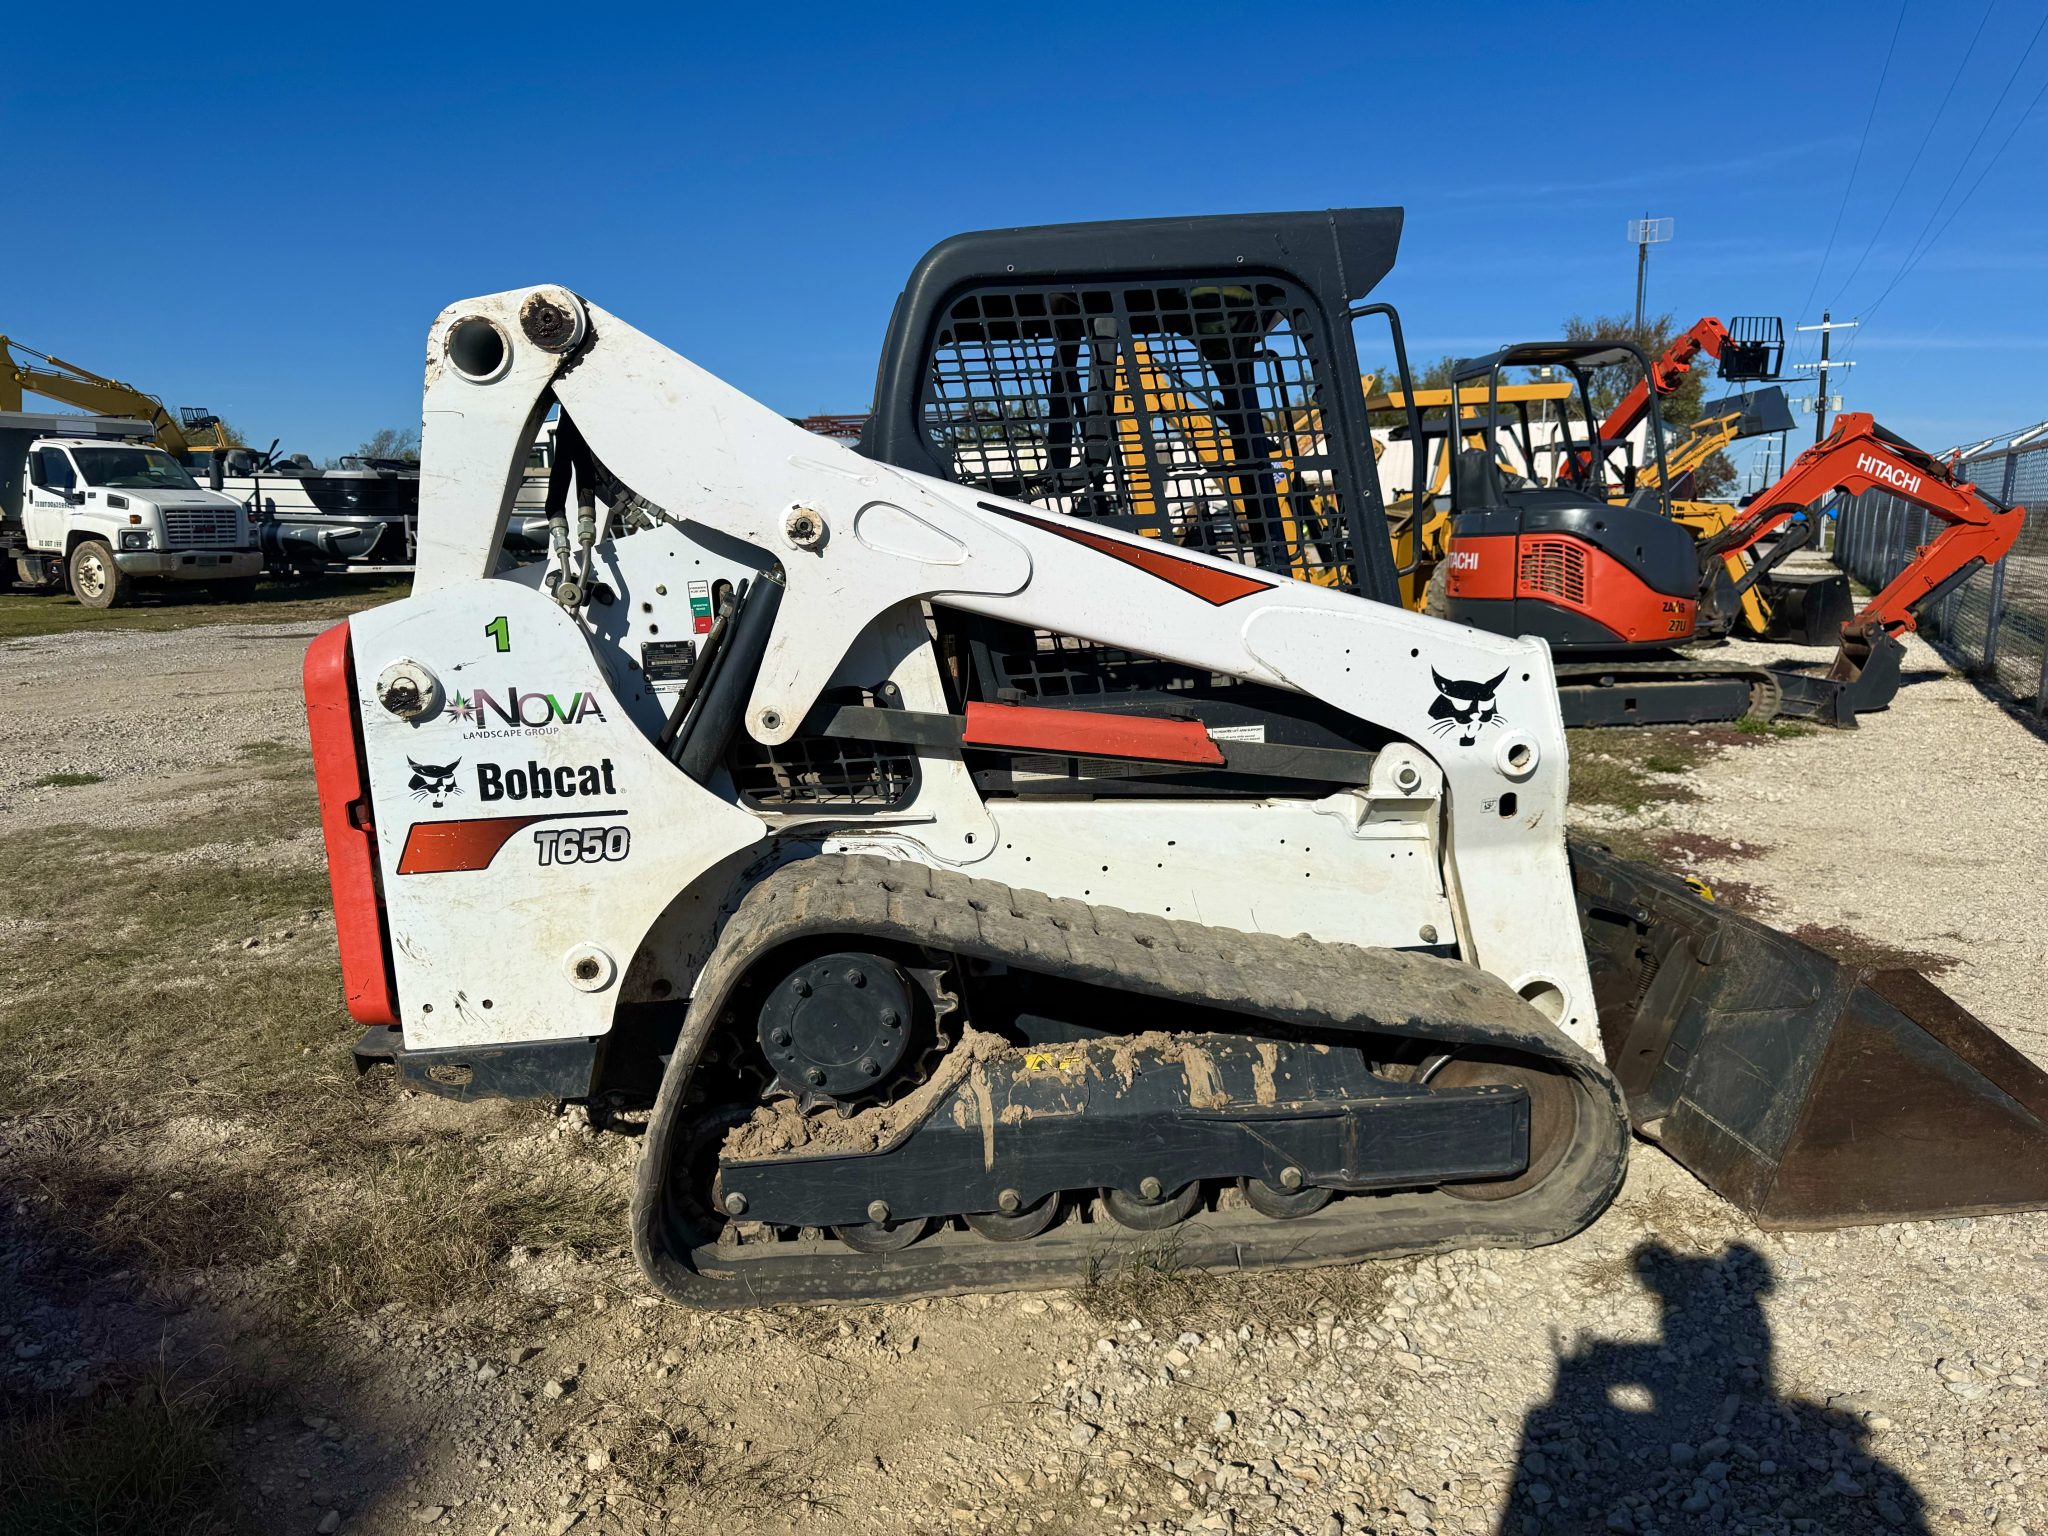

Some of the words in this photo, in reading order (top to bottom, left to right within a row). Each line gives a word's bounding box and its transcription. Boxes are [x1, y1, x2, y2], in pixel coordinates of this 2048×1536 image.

[1856, 453, 1921, 493] HITACHI
[1662, 601, 1685, 613] ZAXIS
[1667, 619, 1687, 632] 27U
[485, 616, 511, 653] 1
[463, 730, 522, 740] LANDSCAPE
[525, 727, 559, 737] GROUP
[477, 758, 617, 802] Bobcat
[534, 826, 631, 867] T650
